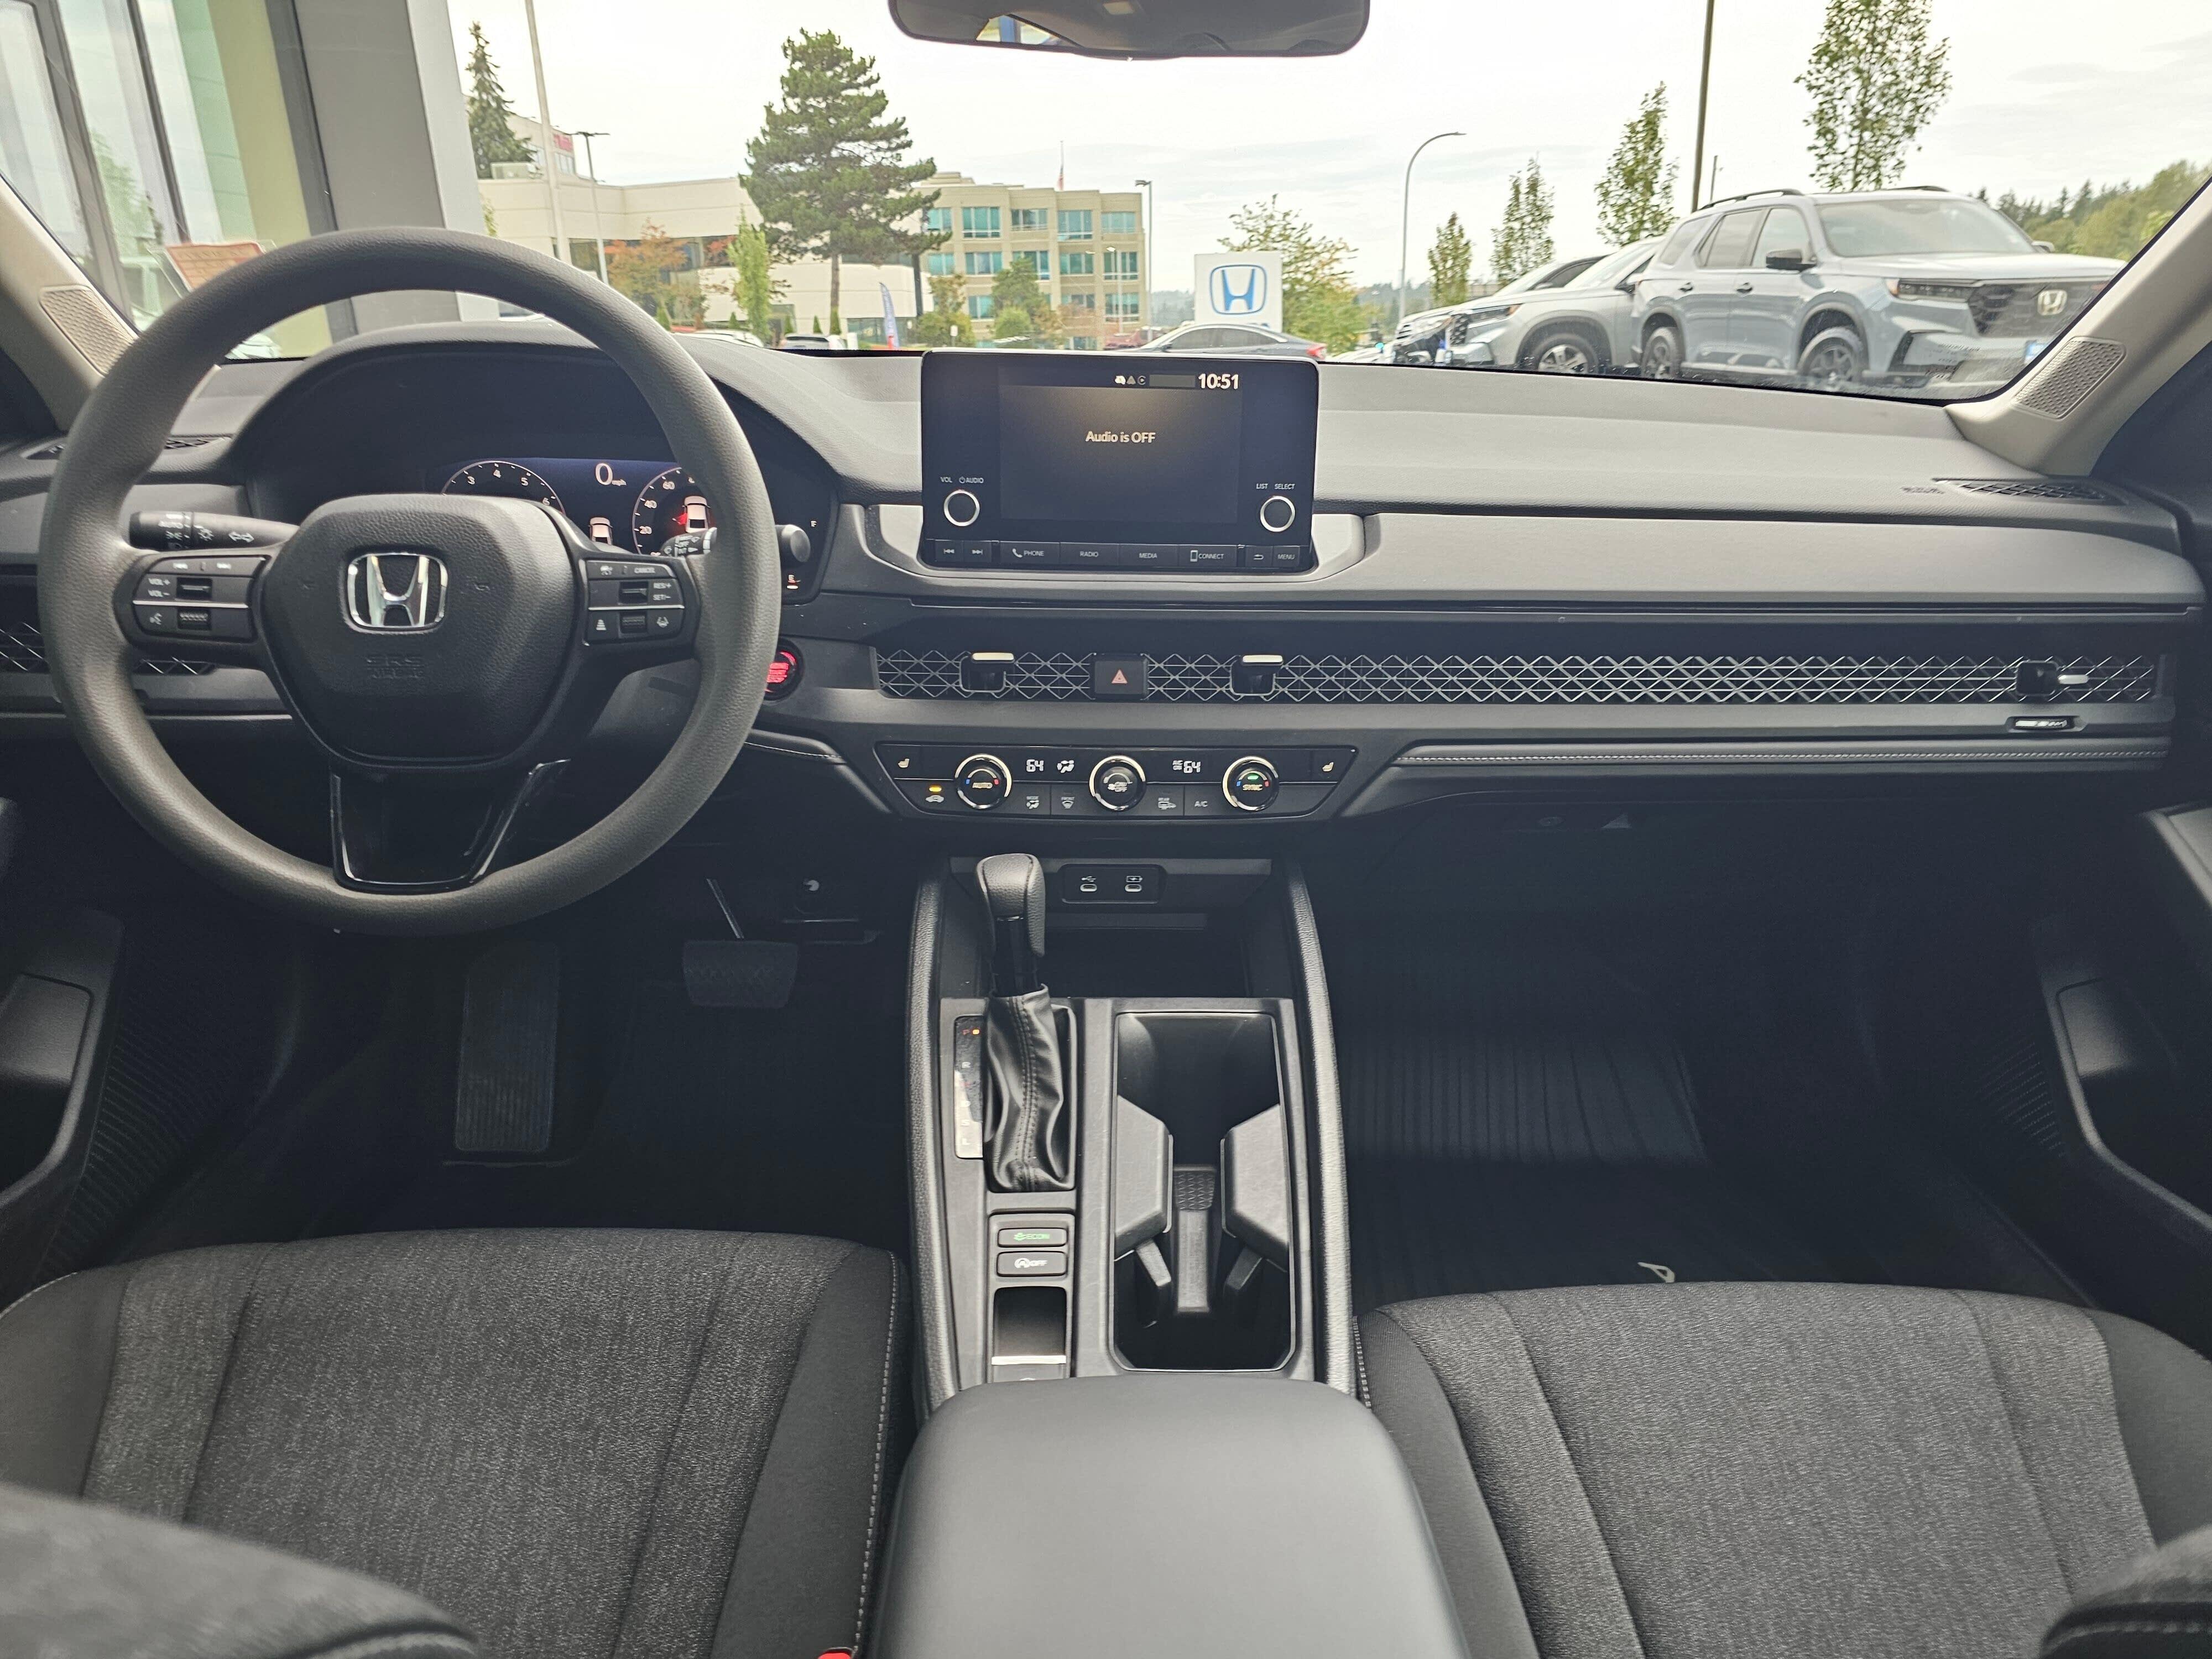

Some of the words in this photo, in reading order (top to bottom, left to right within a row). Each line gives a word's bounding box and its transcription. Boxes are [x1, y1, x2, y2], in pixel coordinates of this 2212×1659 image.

[1198, 373, 1239, 389] 10:51
[1085, 431, 1119, 442] Audio
[1120, 431, 1130, 442] is
[1131, 431, 1156, 443] OFF
[493, 469, 502, 478] 4
[595, 463, 613, 486] 0
[467, 476, 476, 485] 3
[521, 477, 529, 486] 5
[1026, 759, 1045, 773] 64
[1183, 760, 1201, 774] 64
